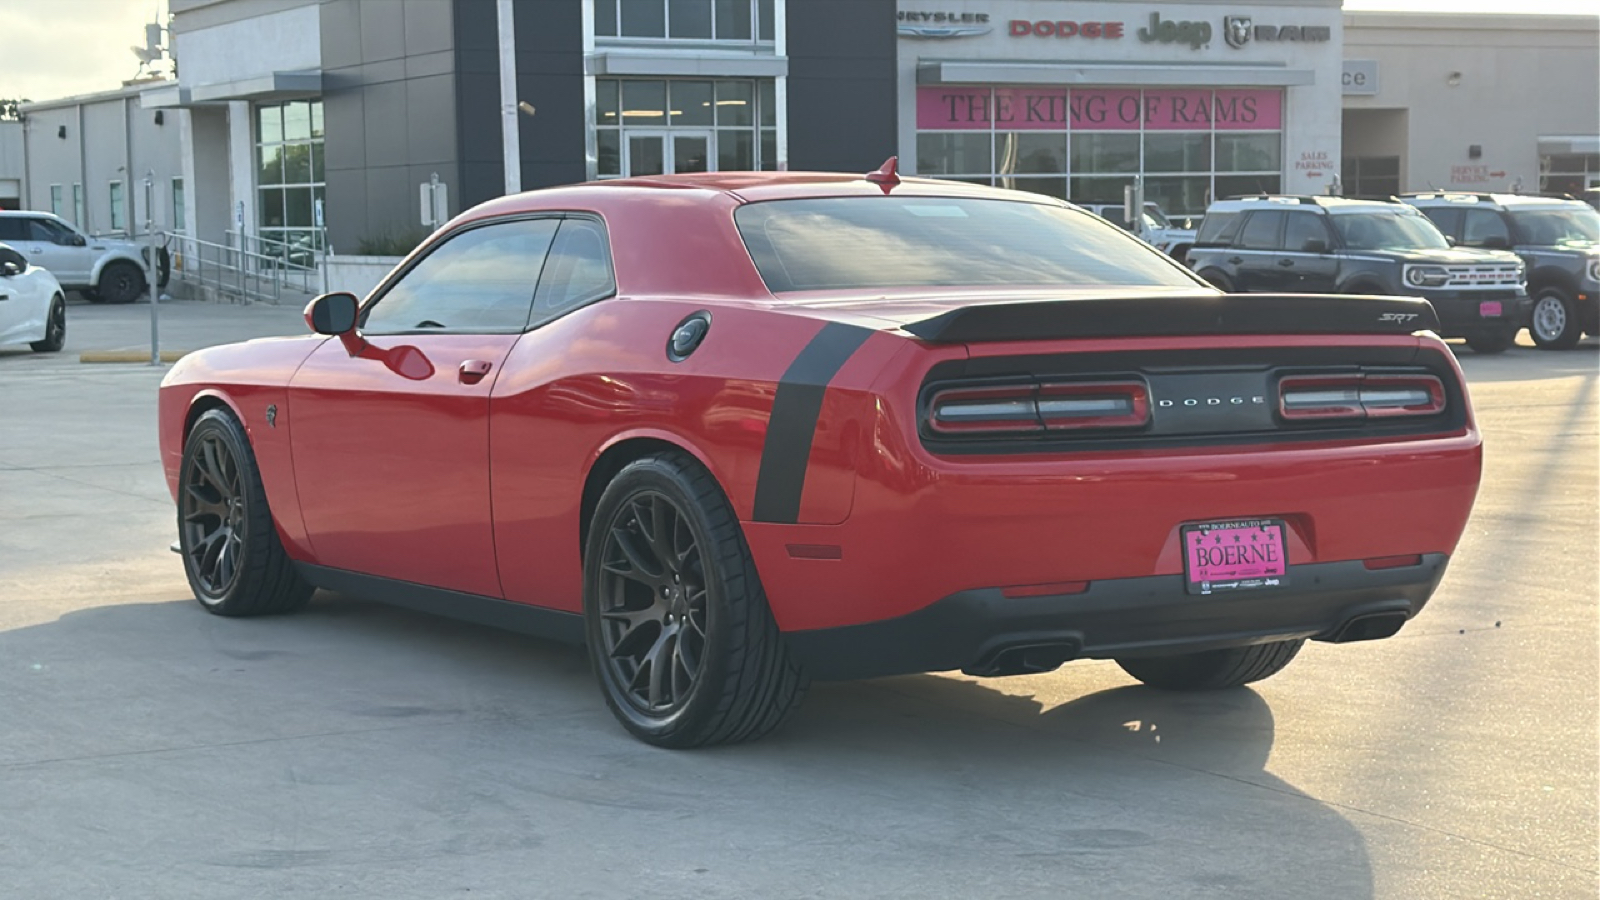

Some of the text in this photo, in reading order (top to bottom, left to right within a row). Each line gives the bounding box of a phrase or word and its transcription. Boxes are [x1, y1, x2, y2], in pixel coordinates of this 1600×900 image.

[897, 10, 990, 23] HRYSLER
[1008, 19, 1124, 38] DODGE
[1137, 11, 1212, 50] Jeep
[1254, 25, 1331, 41] RAM
[942, 94, 1258, 124] THE KING OF RAMS
[1300, 151, 1328, 160] SALES
[1295, 160, 1334, 170] PARKING
[1378, 313, 1418, 324] SRT
[1159, 396, 1265, 407] DODGE
[1195, 543, 1279, 568] BOERNE
